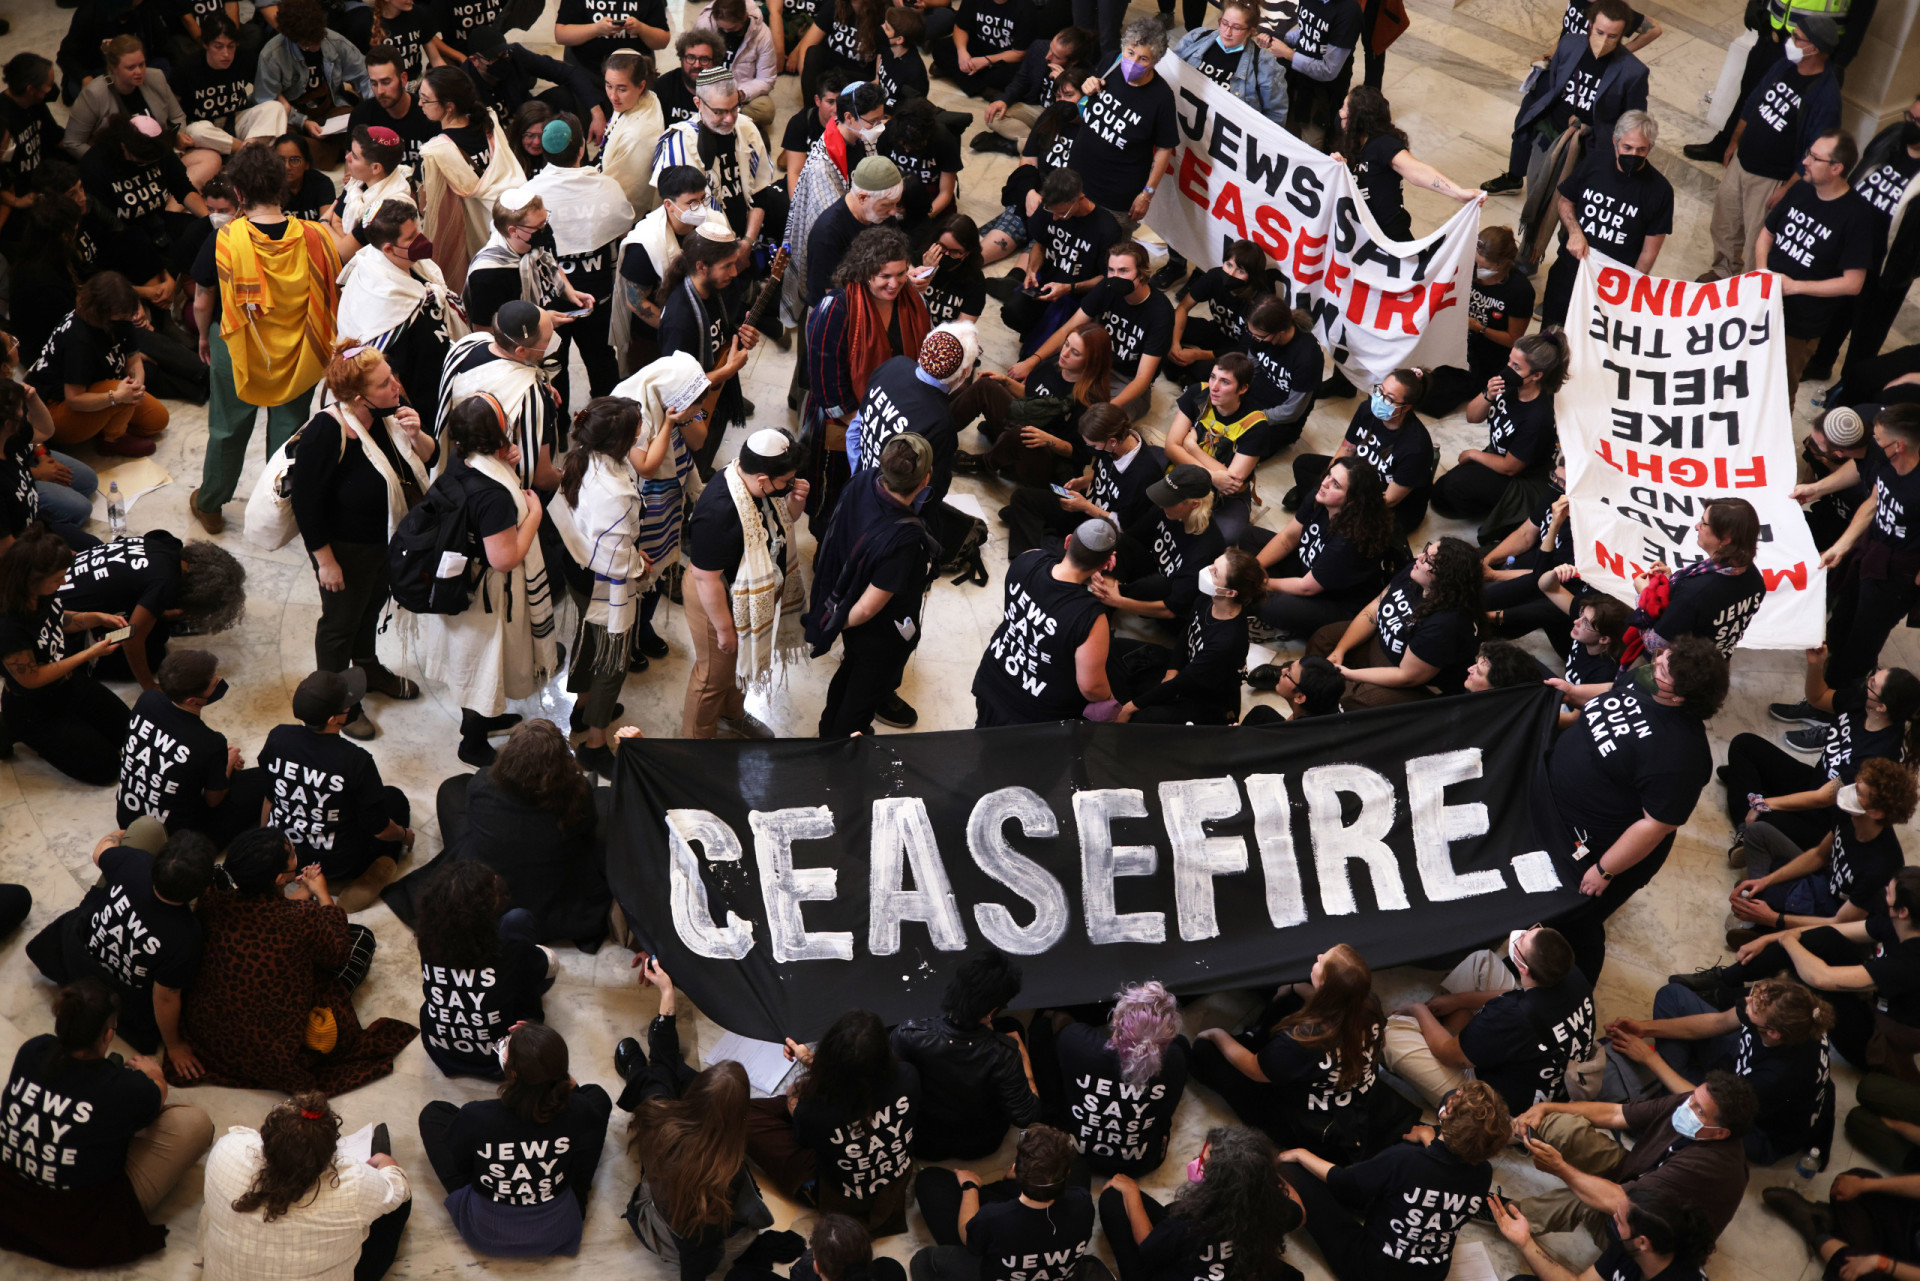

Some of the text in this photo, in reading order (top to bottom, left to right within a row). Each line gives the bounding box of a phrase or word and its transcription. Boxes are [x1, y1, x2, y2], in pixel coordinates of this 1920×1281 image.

[194, 0, 224, 14] OU
[454, 0, 499, 16] NOT IN
[462, 12, 498, 28] OUR
[585, 0, 639, 12] NOT IN
[785, 0, 816, 12] OUR
[1567, 5, 1584, 23] OT
[976, 12, 1015, 30] NOT IN
[981, 24, 1011, 39] OUR
[1317, 18, 1330, 32] IN
[383, 34, 403, 47] OT
[195, 80, 246, 99] NOT IN
[203, 92, 240, 110] OUR
[1765, 89, 1791, 116] OUR
[1774, 82, 1794, 98] OT
[1092, 101, 1126, 135] OUR
[1097, 90, 1142, 127] NOT IN
[1082, 108, 1128, 151] NAME
[890, 150, 936, 169] NOT IN
[1881, 165, 1901, 181] OT
[111, 166, 162, 194] NOT IN
[124, 182, 161, 206] OUR
[1178, 86, 1446, 282] JEWS SAY
[1869, 172, 1903, 200] OUR
[116, 189, 170, 220] NAME
[281, 209, 300, 220] OT
[1582, 188, 1639, 218] NOT IN
[1584, 204, 1625, 229] OUR
[1048, 223, 1092, 253] NOT IN
[1784, 222, 1816, 248] OUR
[1787, 207, 1832, 240] NOT IN
[1052, 238, 1080, 261] OUR
[1153, 144, 1459, 335] EASEFIRE
[924, 285, 964, 308] OT IN
[1598, 266, 1774, 318] LIVING
[929, 301, 954, 318] UR
[1210, 298, 1235, 318] NOT
[1102, 310, 1145, 341] NOT IN
[1104, 323, 1137, 350] OUR
[1588, 303, 1770, 359] FOR THE
[1257, 351, 1279, 373] NOT
[1602, 359, 1749, 406] HELL
[864, 404, 891, 442] SAY
[869, 385, 909, 434] JEWS
[1356, 426, 1382, 448] NOT
[1503, 419, 1516, 437] IN
[1611, 406, 1740, 449] LIKE
[1356, 445, 1388, 474] OUR
[1595, 438, 1768, 489] FIGHT
[1629, 486, 1710, 517] ND
[1890, 498, 1905, 516] IN
[1156, 520, 1177, 552] NOT
[73, 550, 90, 577] IRE
[106, 539, 127, 565] AY
[126, 535, 150, 571] EWS
[1154, 538, 1175, 578] OUR
[1009, 581, 1057, 636] JEWS
[1392, 588, 1413, 617] NOT
[1713, 592, 1761, 626] JEWS
[1006, 601, 1045, 648] SAY
[1381, 602, 1404, 636] OUR
[1714, 612, 1752, 641] SAY
[1004, 612, 1052, 665] EASE
[990, 638, 1047, 697] NOW
[1603, 696, 1631, 738] OUR
[1622, 684, 1653, 739] OT IN
[129, 714, 191, 764] JEWS
[1584, 696, 1617, 758] NAME
[1838, 711, 1852, 744] NOT
[125, 734, 175, 776] SAY
[121, 746, 180, 796] EASE
[268, 757, 345, 792] JEWS
[119, 785, 170, 824] OW
[273, 778, 331, 810] SAY
[274, 797, 341, 823] EASE
[665, 746, 1563, 964] CEASEFIRE.
[1841, 862, 1855, 884] IN
[99, 904, 142, 960] SAY
[110, 884, 161, 956] JEWS
[91, 911, 149, 978] CEASE
[422, 962, 497, 988] JEWS
[430, 986, 486, 1013] SAY
[427, 1002, 501, 1027] CEASE
[1538, 996, 1594, 1052] EWS
[428, 1034, 499, 1057] NOW
[436, 1023, 492, 1041] FIRE
[11, 1077, 94, 1123] JEWS
[1075, 1074, 1166, 1102] JEWS
[829, 1096, 910, 1145] JEWS
[1070, 1104, 1156, 1134] CEASE
[1082, 1093, 1151, 1120] SAY
[8, 1102, 73, 1145] SAY
[1079, 1125, 1140, 1147] FIRE
[477, 1136, 571, 1161] JEWS
[836, 1127, 914, 1171] CEASE
[844, 1119, 904, 1159] SAY
[1069, 1132, 1148, 1161] NOW
[2, 1146, 57, 1183] FIRE
[489, 1158, 559, 1182] SAY
[852, 1151, 908, 1184] FIRE
[480, 1171, 565, 1196] CEASE
[1403, 1187, 1482, 1216] JEWS
[1405, 1208, 1467, 1231] SAY
[1001, 1240, 1087, 1269] JEWS
